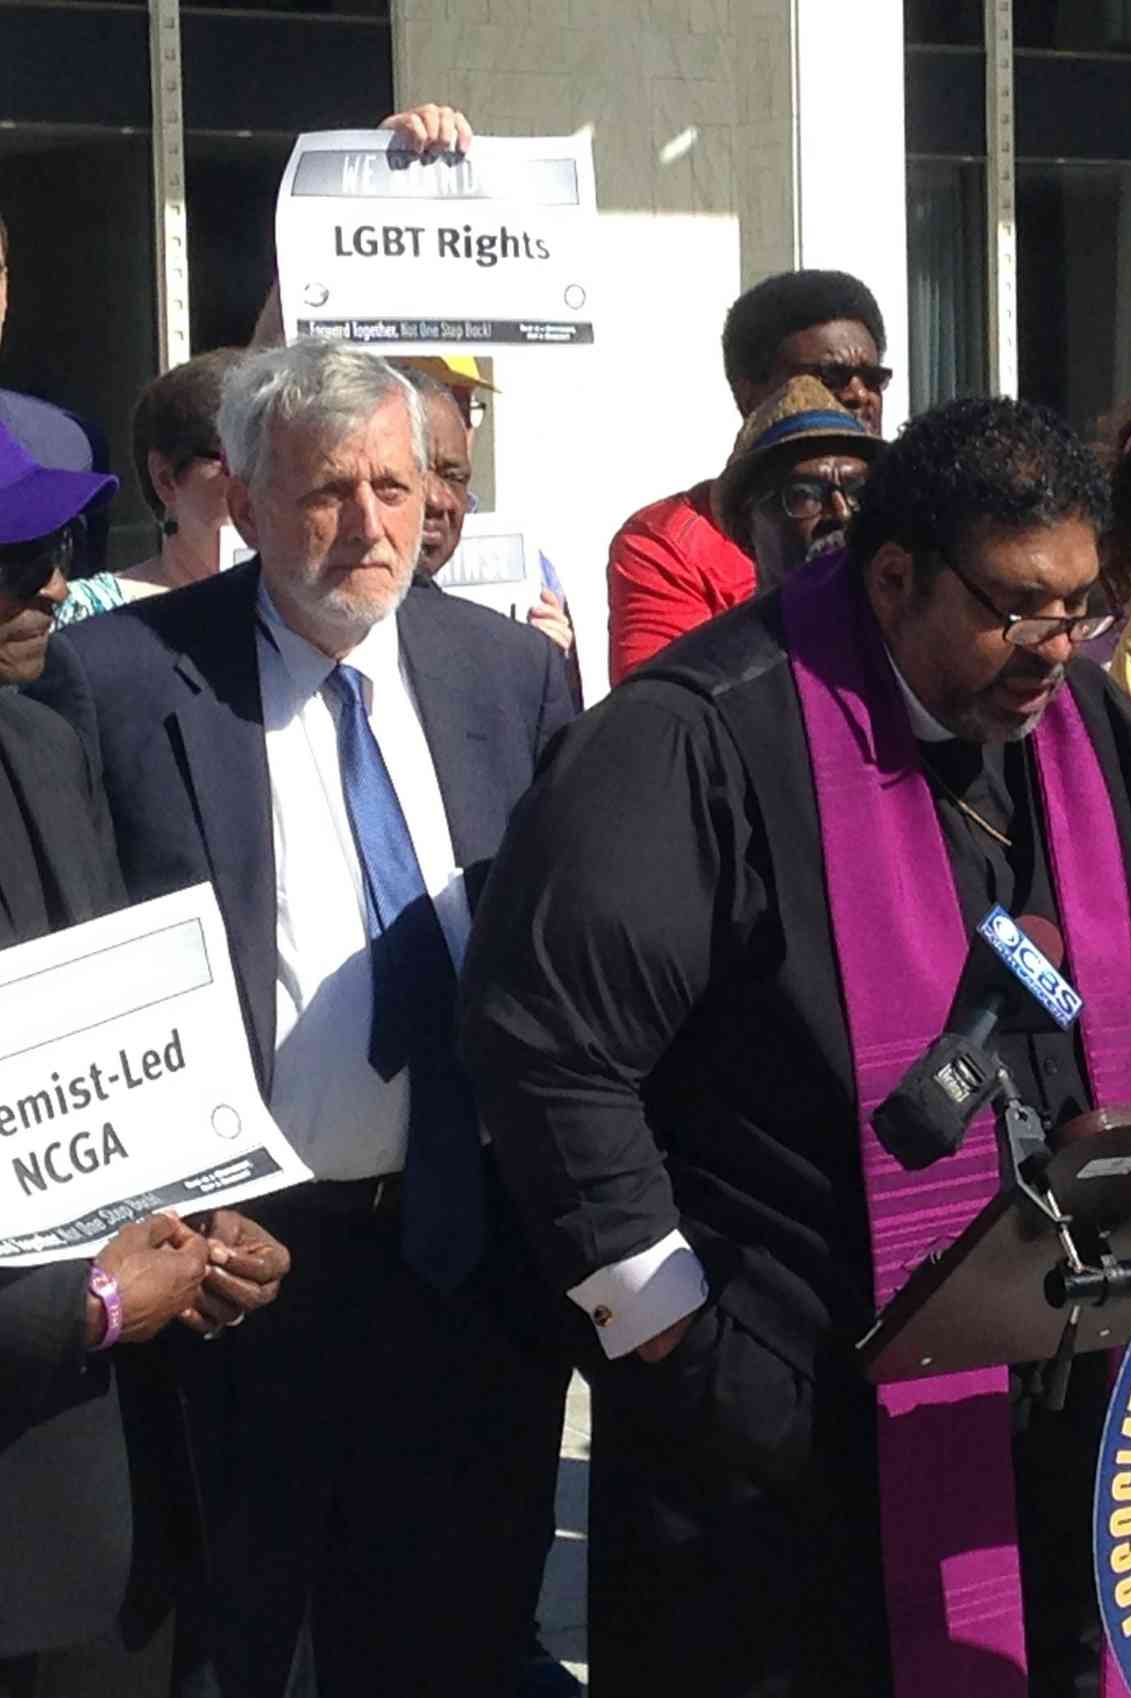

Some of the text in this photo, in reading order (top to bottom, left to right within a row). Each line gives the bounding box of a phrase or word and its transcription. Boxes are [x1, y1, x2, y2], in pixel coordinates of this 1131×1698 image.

[334, 225, 551, 267] LGBT Rights
[1018, 941, 1079, 1016] CBS
[12, 1121, 129, 1197] NCGA
